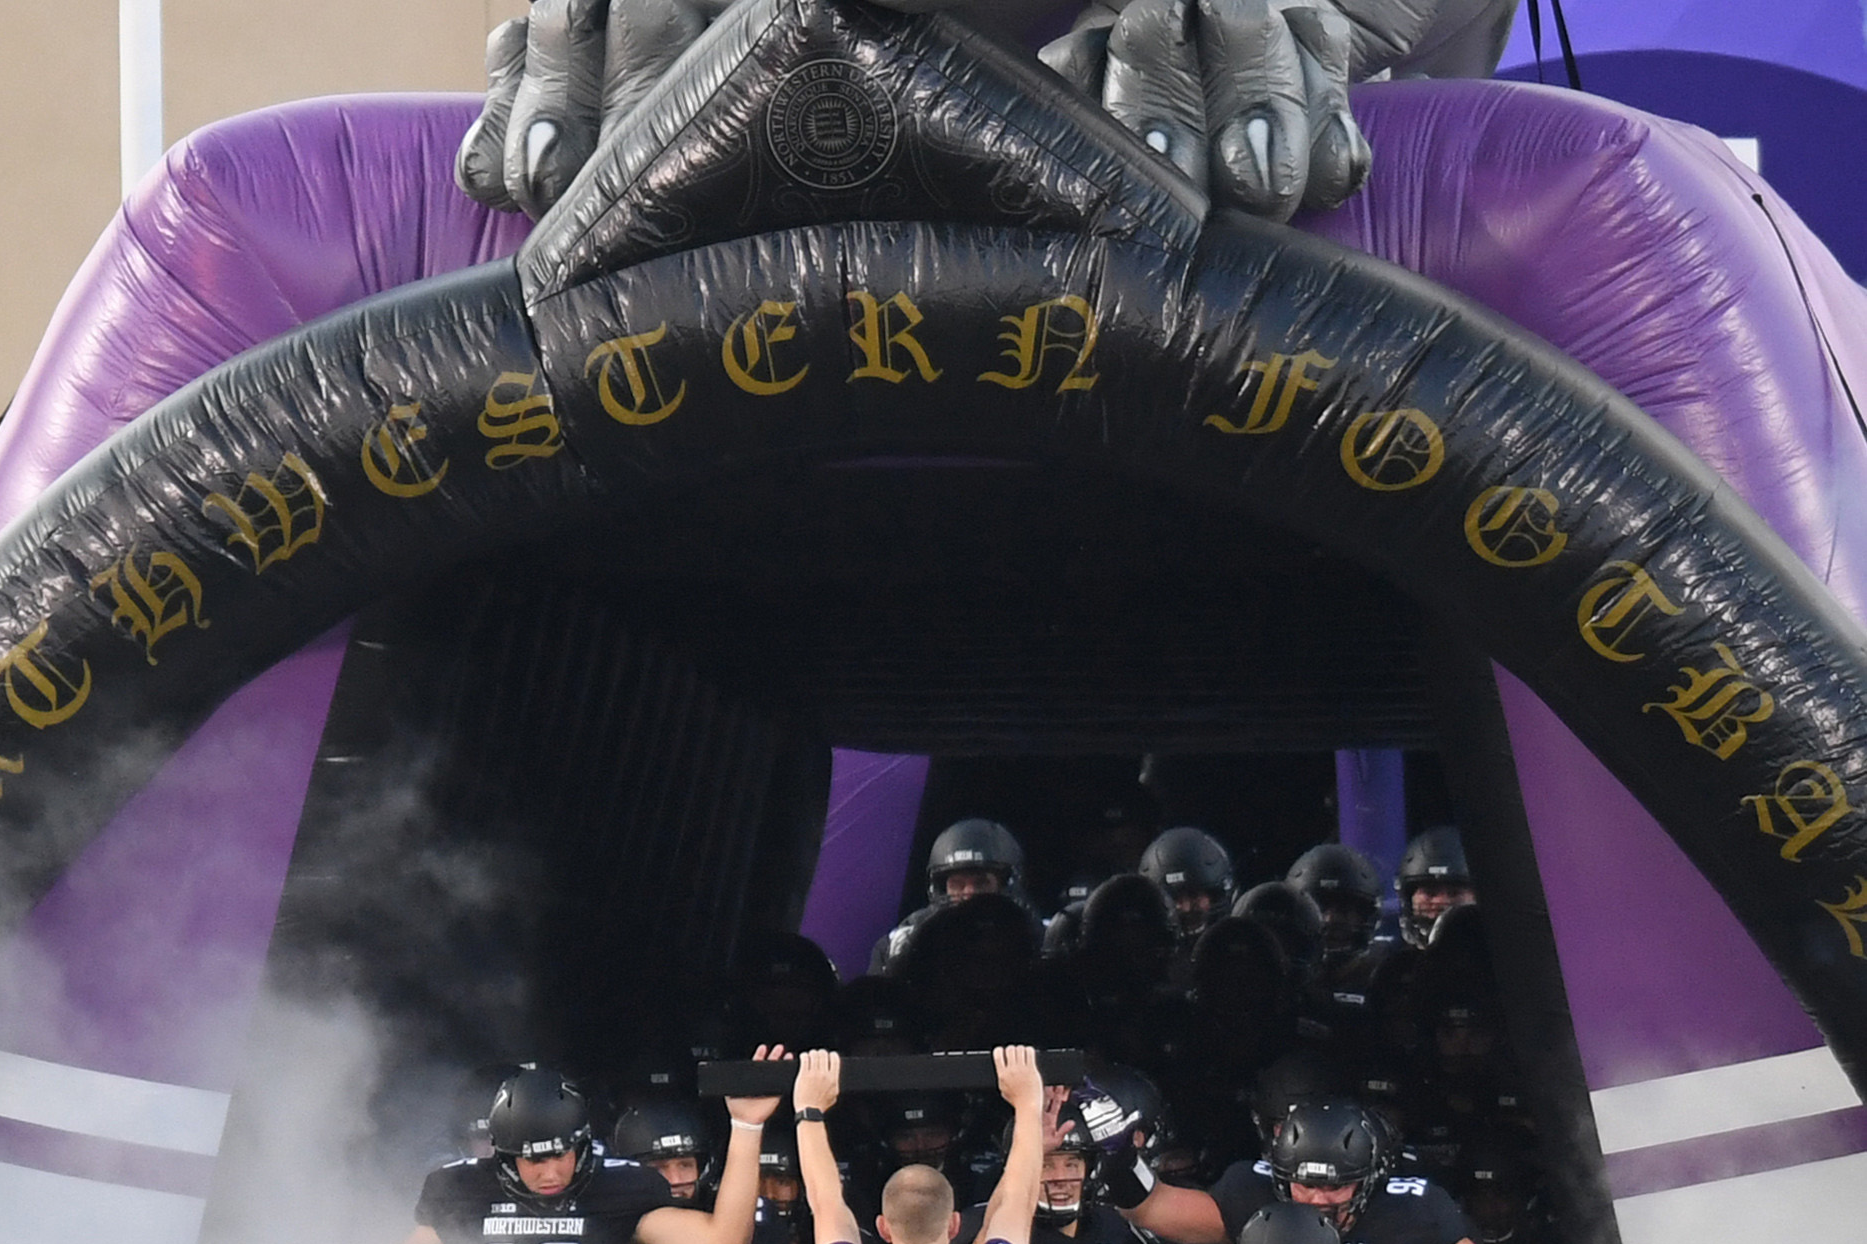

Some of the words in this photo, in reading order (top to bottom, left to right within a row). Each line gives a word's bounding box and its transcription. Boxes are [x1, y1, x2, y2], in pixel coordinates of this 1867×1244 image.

[771, 64, 843, 167] NORTHWESTERN
[821, 170, 856, 185] 1851
[482, 1216, 585, 1236] NORTHWESTERN
